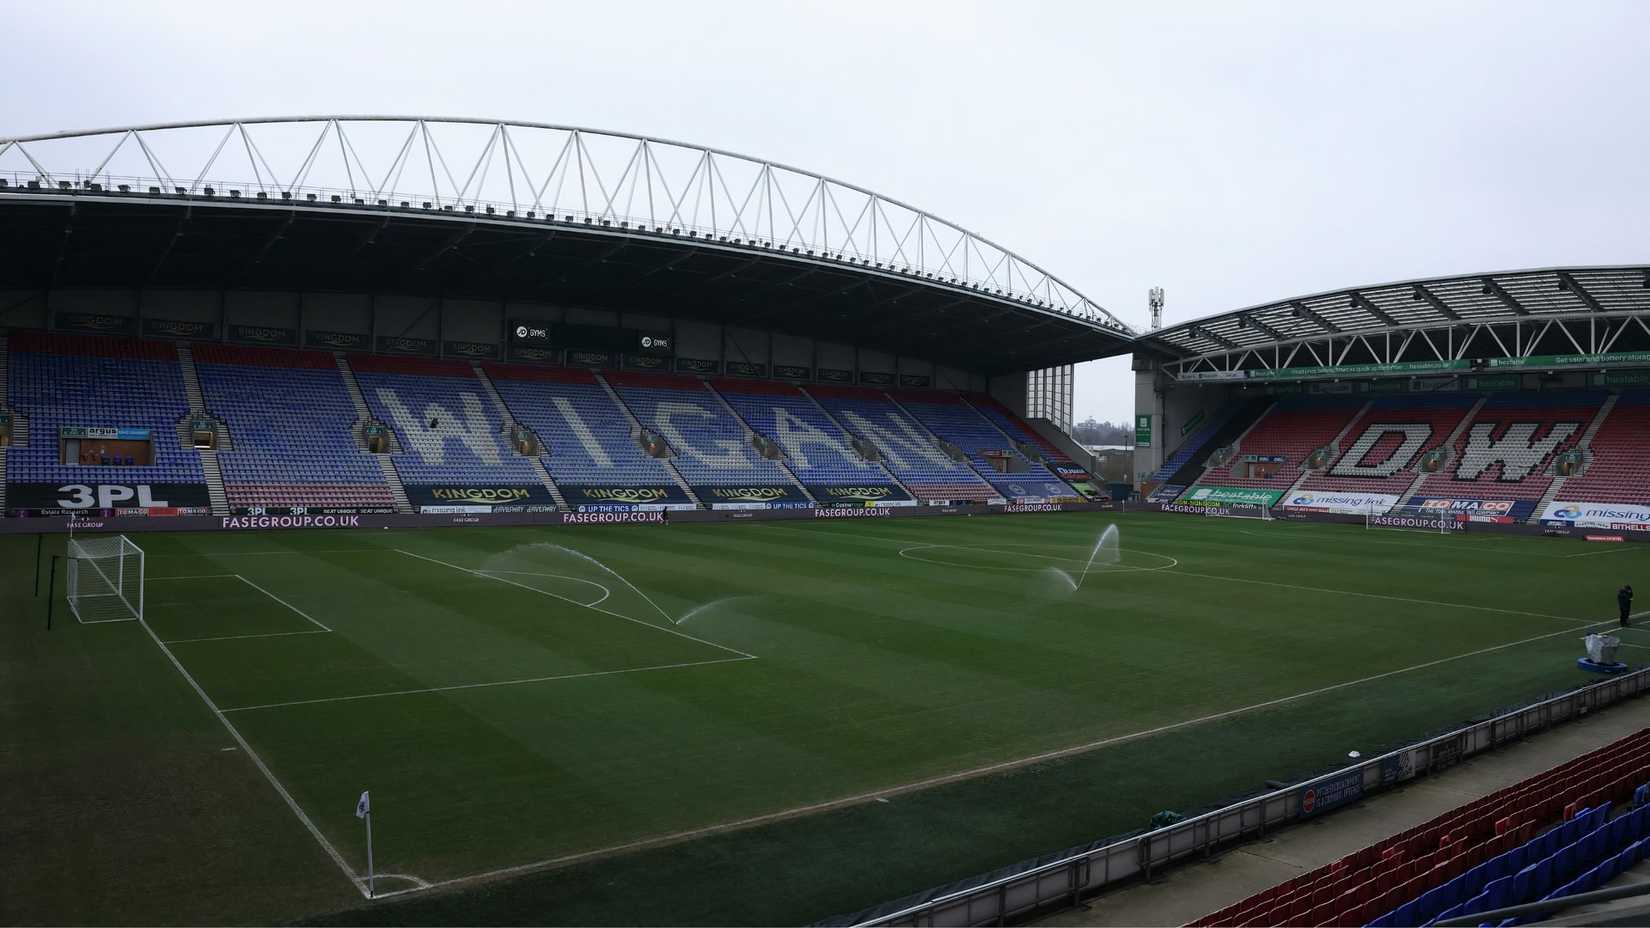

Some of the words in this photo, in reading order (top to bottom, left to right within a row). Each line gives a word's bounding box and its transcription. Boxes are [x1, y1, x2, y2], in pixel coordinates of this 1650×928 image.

[89, 427, 117, 436] argus
[377, 387, 956, 470] WIGAN
[57, 484, 169, 508] 3PL
[432, 488, 530, 499] KINGDOM
[583, 488, 669, 498] KINGDOM
[712, 488, 789, 497] KINGDOM
[826, 487, 893, 496] KINGDOM
[1316, 496, 1362, 506] missing
[815, 508, 891, 518] FASEGROUP.CO.UK
[1004, 504, 1062, 513] FASEGROUP.CO.UK
[563, 512, 664, 523] FASEGROUP.CO.UK
[1586, 509, 1650, 521] missing
[223, 516, 359, 528] FASEGROUP.CO.UK
[1373, 516, 1465, 531] ASEGROUP.CO.UK
